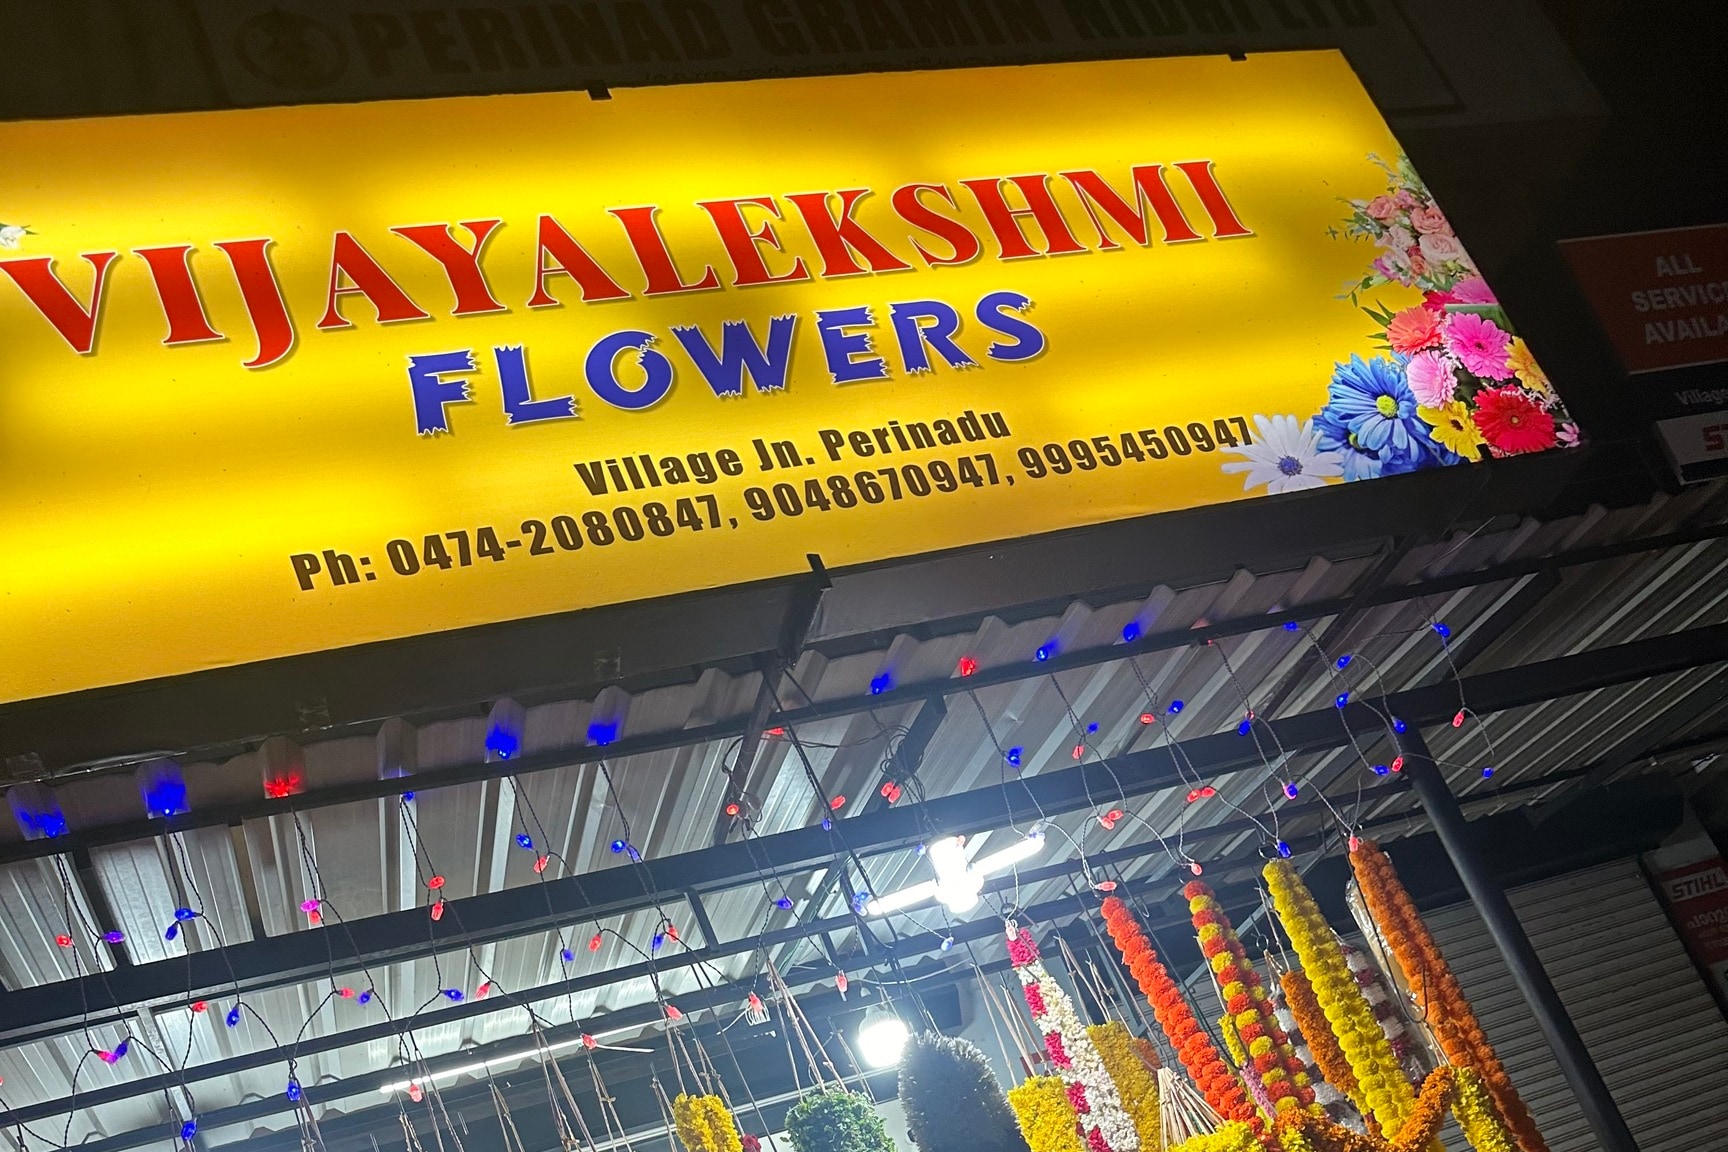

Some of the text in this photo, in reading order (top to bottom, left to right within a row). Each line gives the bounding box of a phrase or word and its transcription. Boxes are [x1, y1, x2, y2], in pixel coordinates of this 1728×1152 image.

[1, 160, 1256, 369] VIJAYALEKSHMI
[1656, 254, 1704, 278] ALL
[407, 291, 1049, 438] FLOWERS
[290, 415, 1254, 591] Ph: 0474-2080847, 9048670947, 9995450947
[574, 410, 1011, 496] Village Jn. Perinadu
[1672, 872, 1726, 900] STIHL
